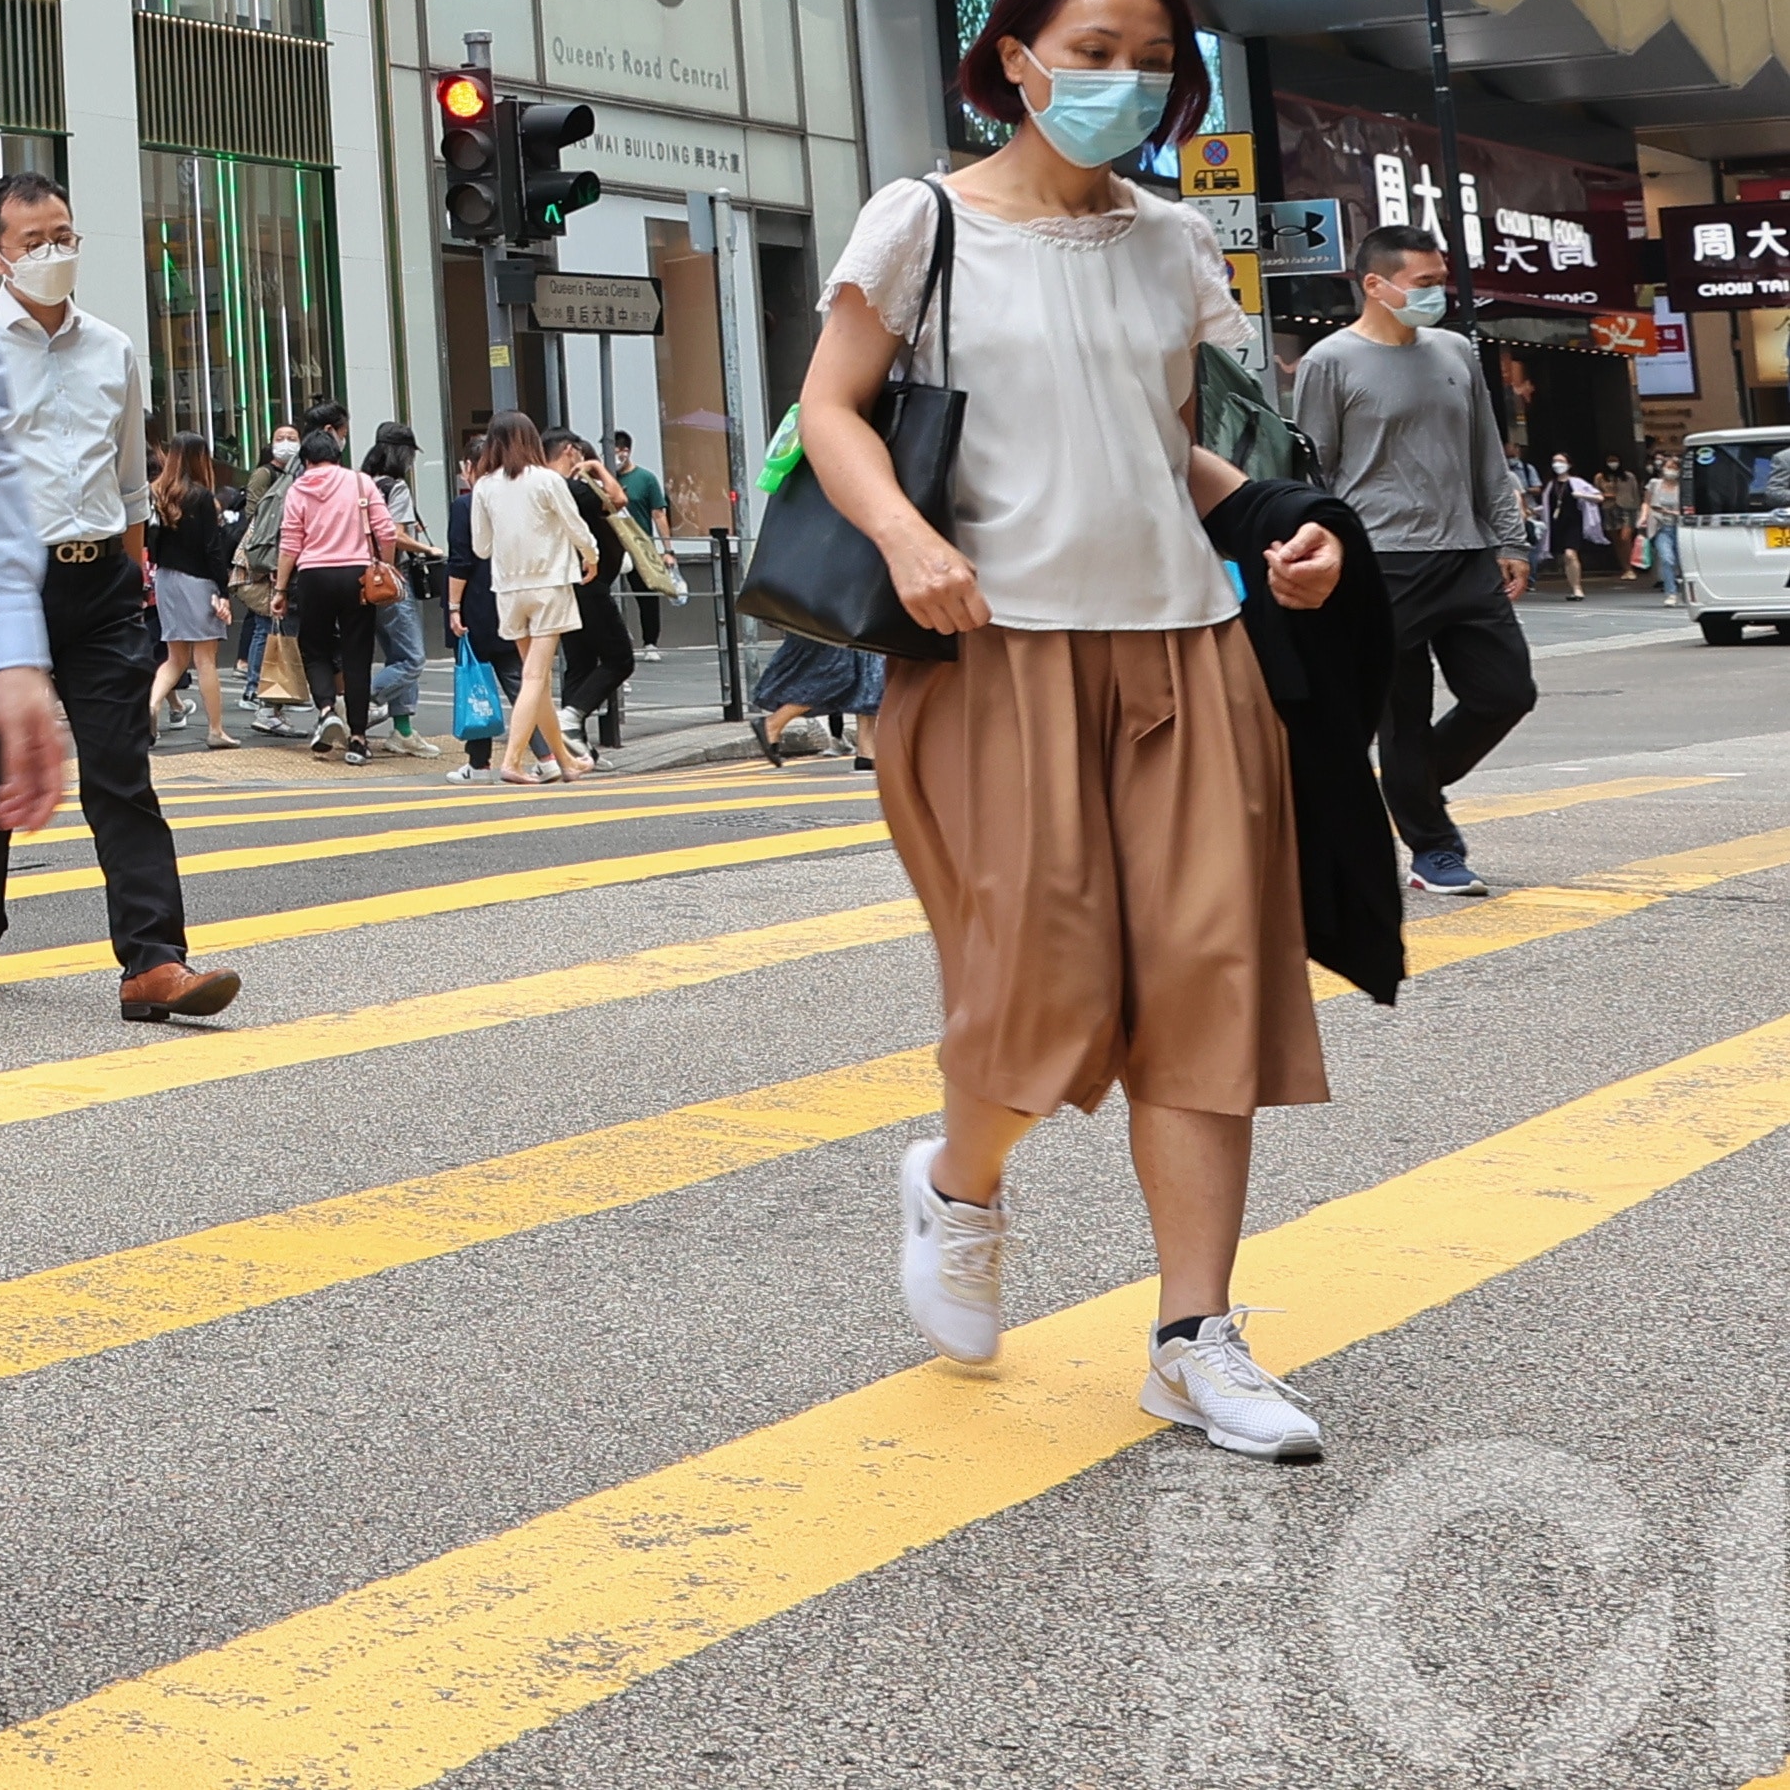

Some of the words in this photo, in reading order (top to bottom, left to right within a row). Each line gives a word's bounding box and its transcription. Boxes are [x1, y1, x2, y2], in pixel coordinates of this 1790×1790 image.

[553, 37, 615, 72] Queen's
[623, 49, 662, 79] Road
[670, 58, 729, 91] Central
[594, 133, 619, 154] WAI
[625, 138, 689, 165] BUILDING
[1228, 200, 1241, 216] 7
[1496, 208, 1531, 238] CHOW
[1532, 215, 1551, 242] TAI
[1231, 229, 1253, 246] 12
[1693, 221, 1790, 261] 周大
[1698, 282, 1753, 297] CHOW
[1757, 279, 1790, 294] TAI
[566, 305, 628, 325] 皇后大道中
[1236, 349, 1249, 365] 7
